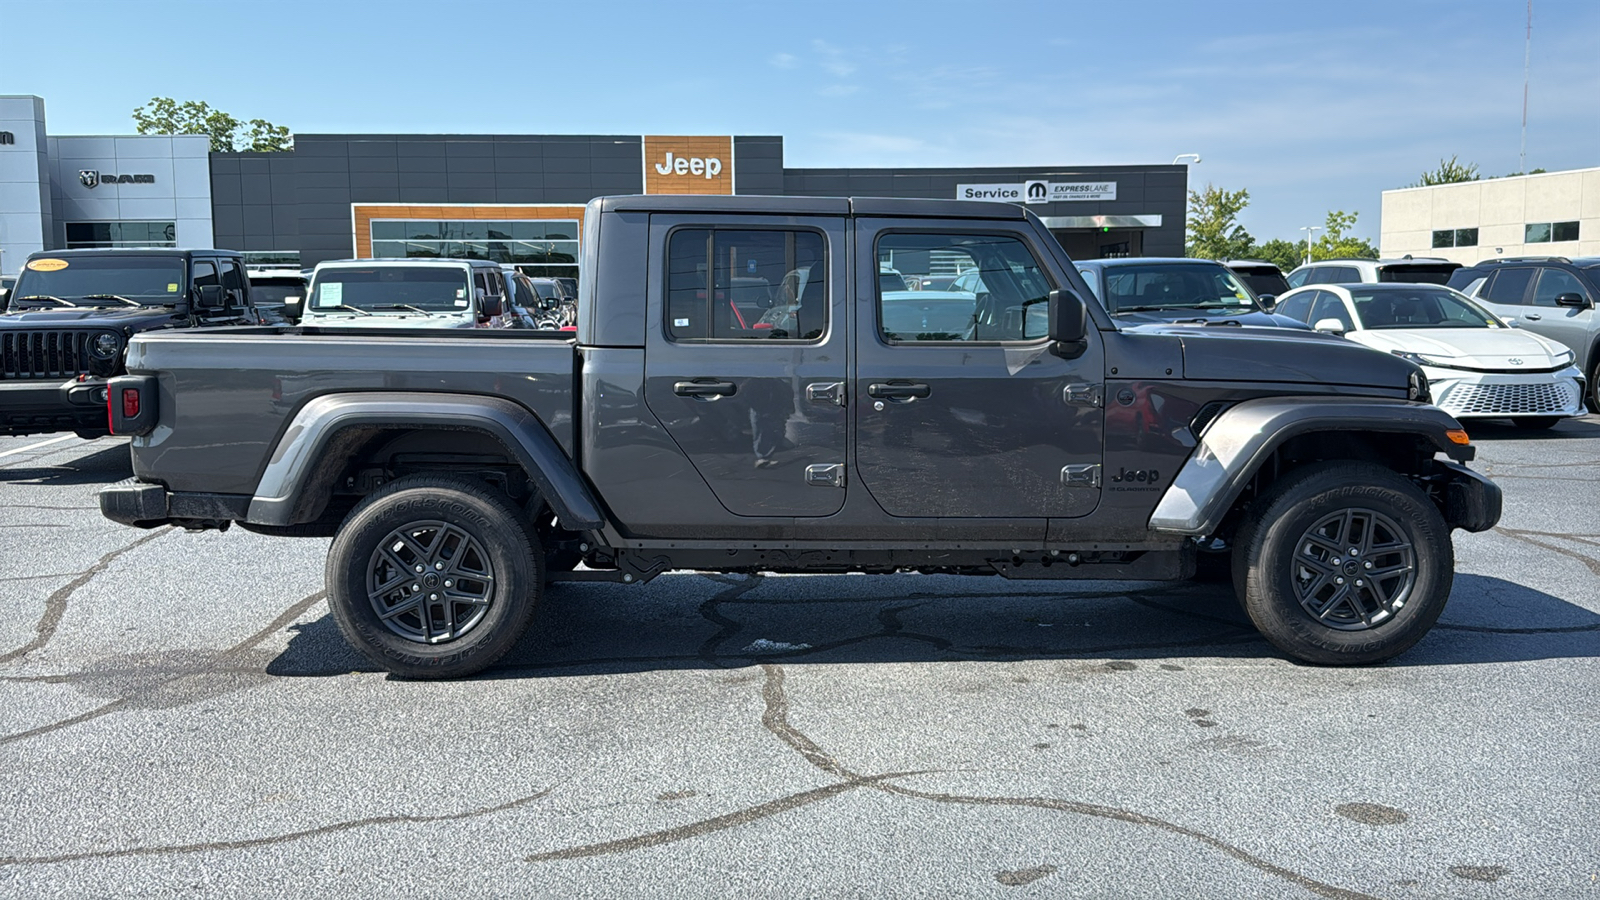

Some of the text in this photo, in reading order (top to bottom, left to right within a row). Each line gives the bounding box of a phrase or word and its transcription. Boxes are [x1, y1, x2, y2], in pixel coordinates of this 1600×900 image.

[655, 152, 722, 179] Jeep
[101, 174, 155, 184] RAM
[965, 188, 1019, 199] Service
[1111, 467, 1160, 485] Jeep
